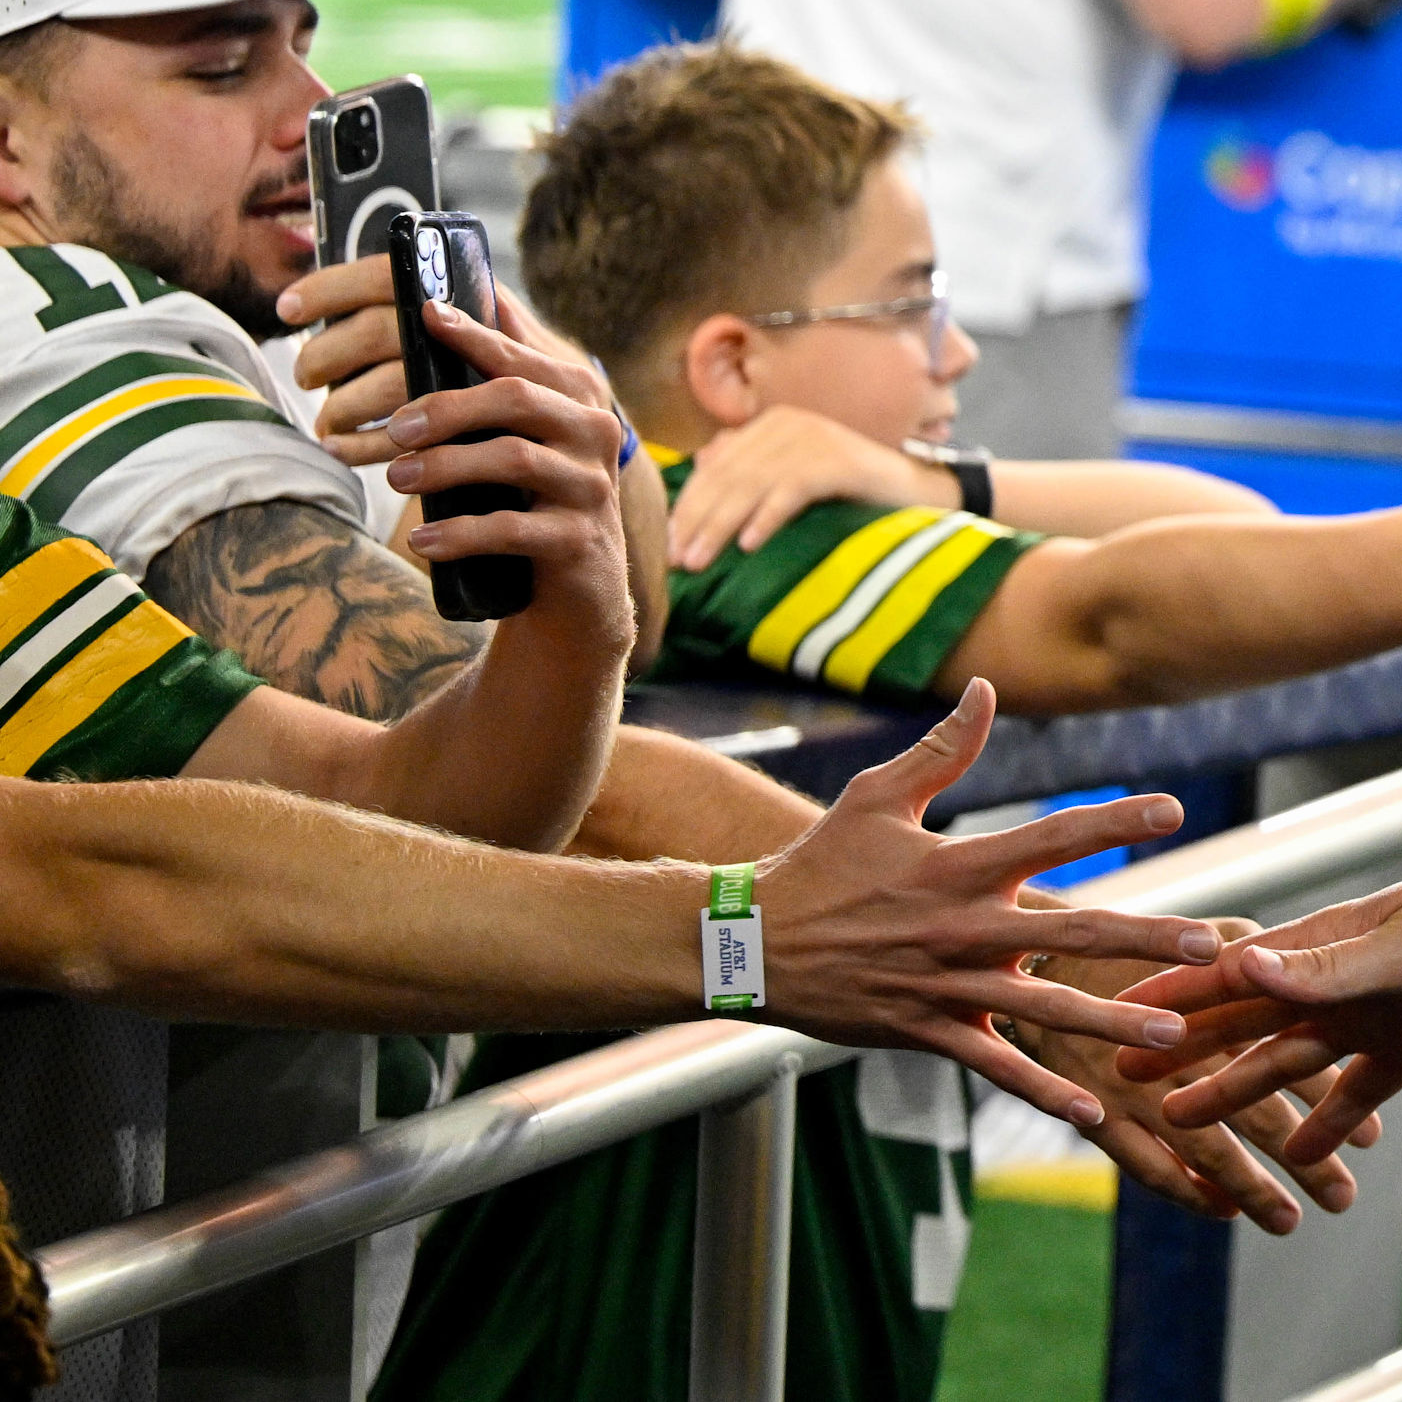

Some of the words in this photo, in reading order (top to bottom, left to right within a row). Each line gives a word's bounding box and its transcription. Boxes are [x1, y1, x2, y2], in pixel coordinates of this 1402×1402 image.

[717, 879, 744, 915] CLUB
[718, 927, 733, 986] STADIUM
[732, 939, 746, 972] AT&T
